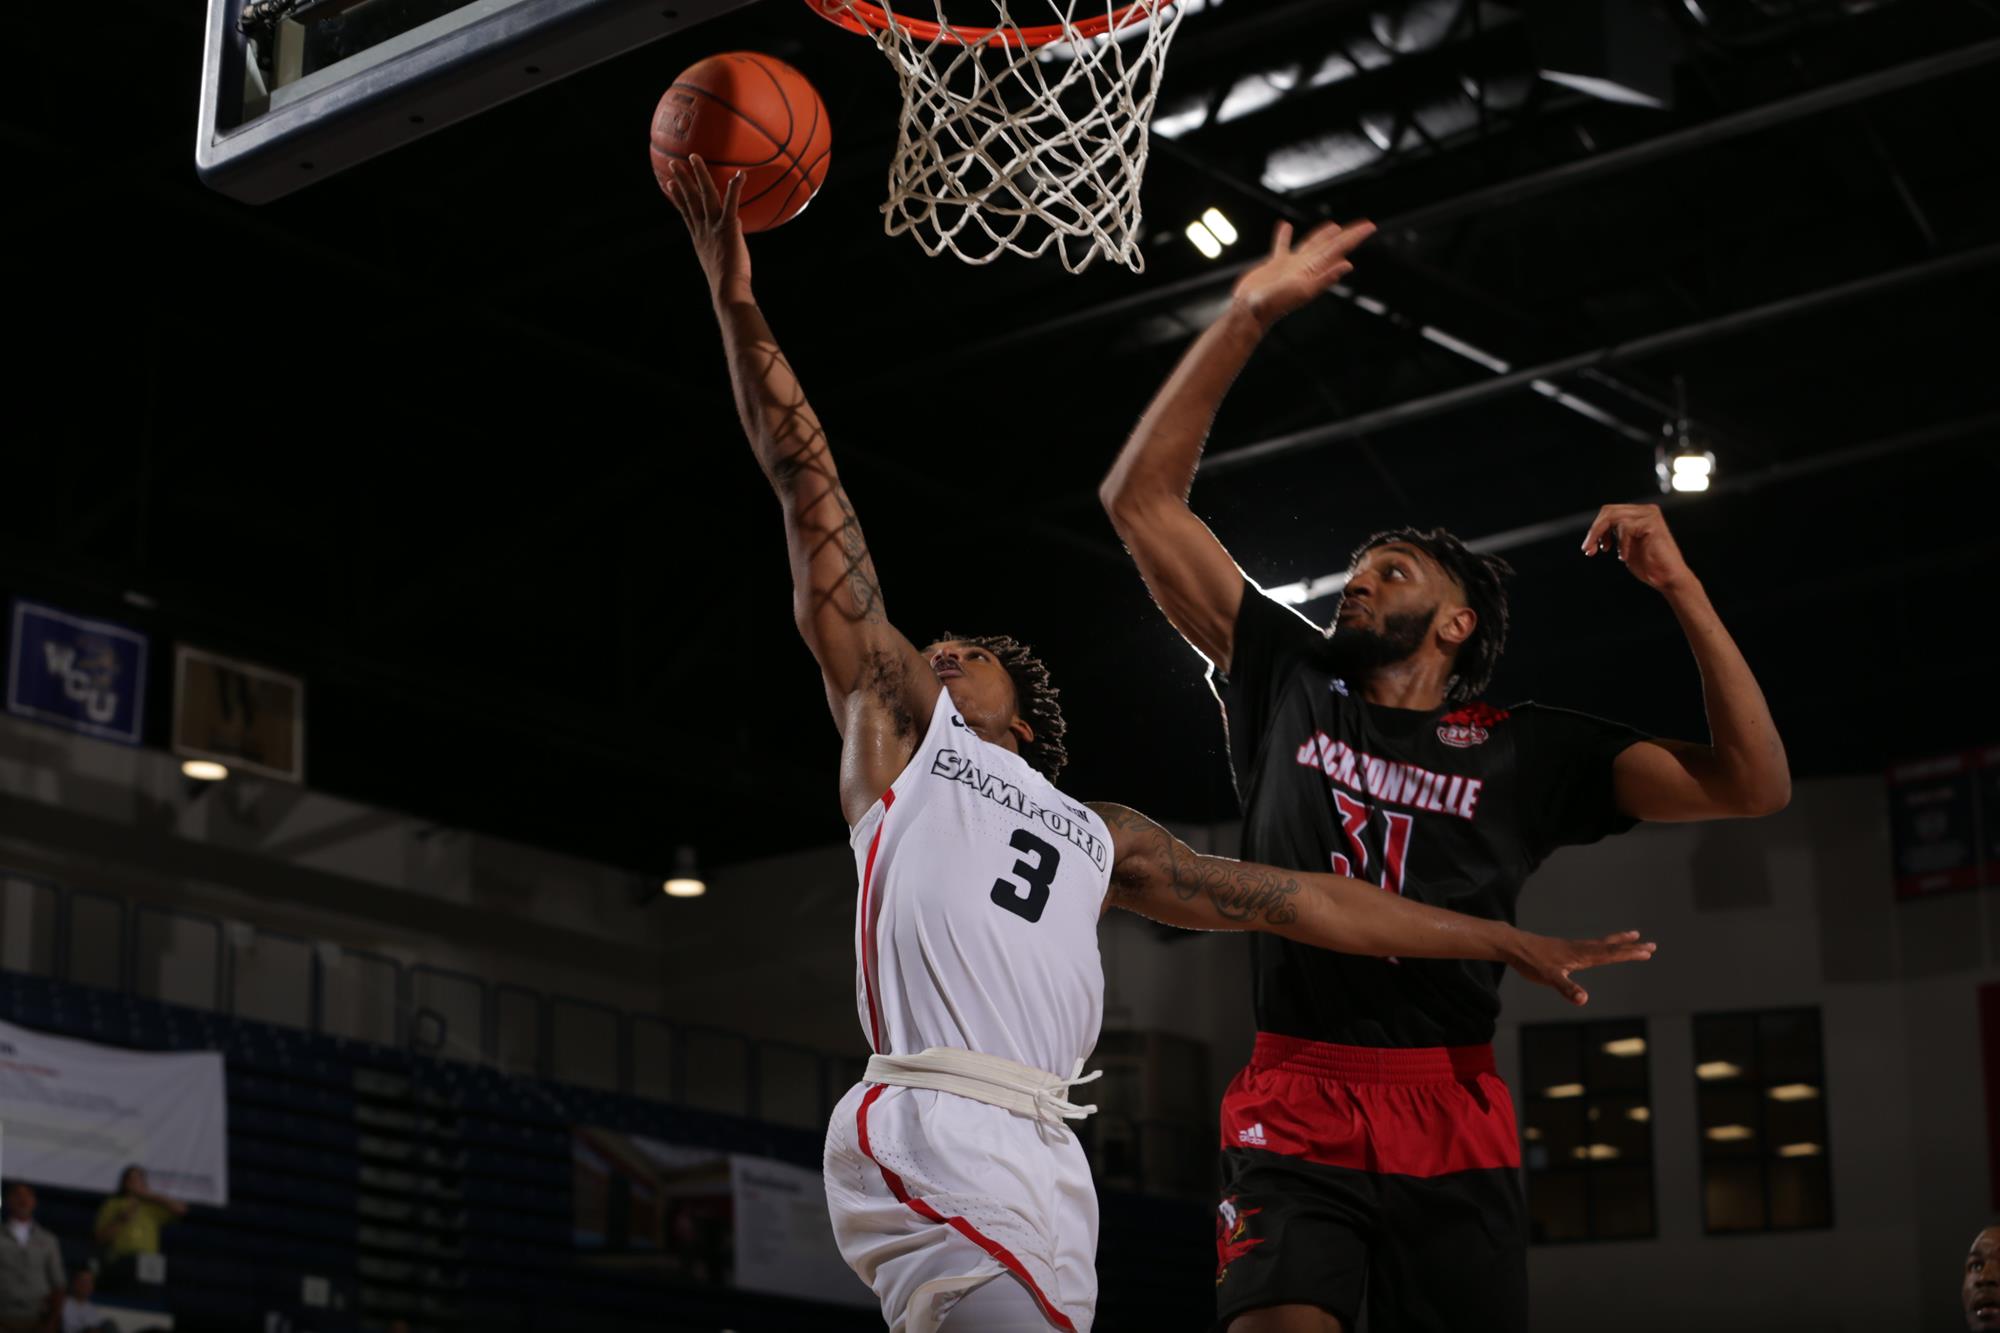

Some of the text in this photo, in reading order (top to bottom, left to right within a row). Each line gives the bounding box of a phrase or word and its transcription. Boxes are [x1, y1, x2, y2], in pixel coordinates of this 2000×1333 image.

[42, 638, 119, 723] WCU
[930, 748, 1107, 873] SAMFORD
[1330, 787, 1414, 896] 31
[990, 828, 1060, 924] 3
